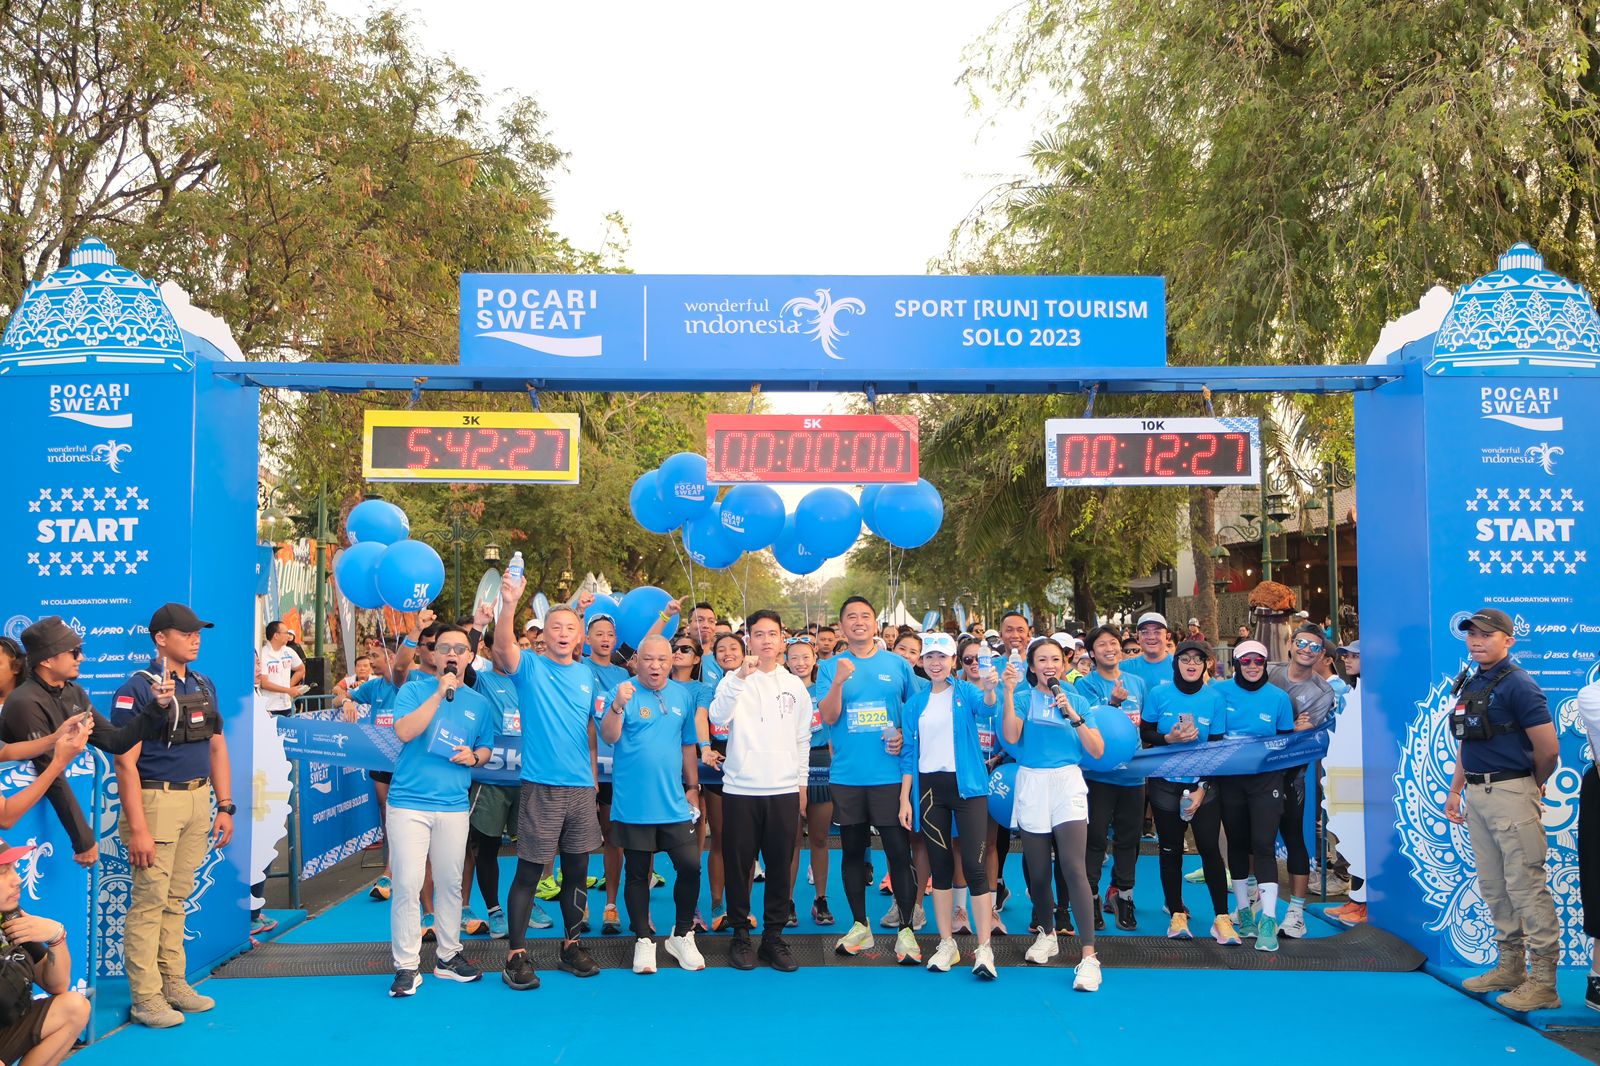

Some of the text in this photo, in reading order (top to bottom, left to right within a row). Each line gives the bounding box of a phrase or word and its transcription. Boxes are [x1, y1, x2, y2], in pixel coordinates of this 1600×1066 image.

[477, 288, 597, 309] POCARI
[684, 298, 770, 313] wonderful
[894, 299, 1148, 321] SPORT [RUN] TOURISM
[476, 310, 586, 330] SWEAT
[684, 314, 801, 335] indonesia
[962, 328, 1081, 347] SOLO 2023
[50, 383, 130, 399] POCARI
[1481, 387, 1559, 400] POCARI
[49, 397, 123, 412] SWEAT
[1481, 401, 1552, 414] SWEAT
[462, 415, 480, 426] 3K
[803, 418, 822, 429] 5K
[1140, 420, 1166, 431] 10K
[47, 445, 87, 453] wonderful
[407, 428, 565, 471] 5:42:27
[721, 431, 905, 473] 00:00:00
[1063, 433, 1245, 477] 00:12:27
[47, 453, 102, 463] indonesia
[1481, 454, 1535, 464] indonesia
[36, 517, 139, 544] START
[1475, 518, 1575, 542] START
[413, 583, 429, 598] 5K
[50, 598, 108, 606] COLLABORATION
[402, 598, 430, 609] 0:30
[859, 712, 887, 723] 3226
[310, 768, 329, 784] SWEAT
[994, 782, 1010, 800] 5K
